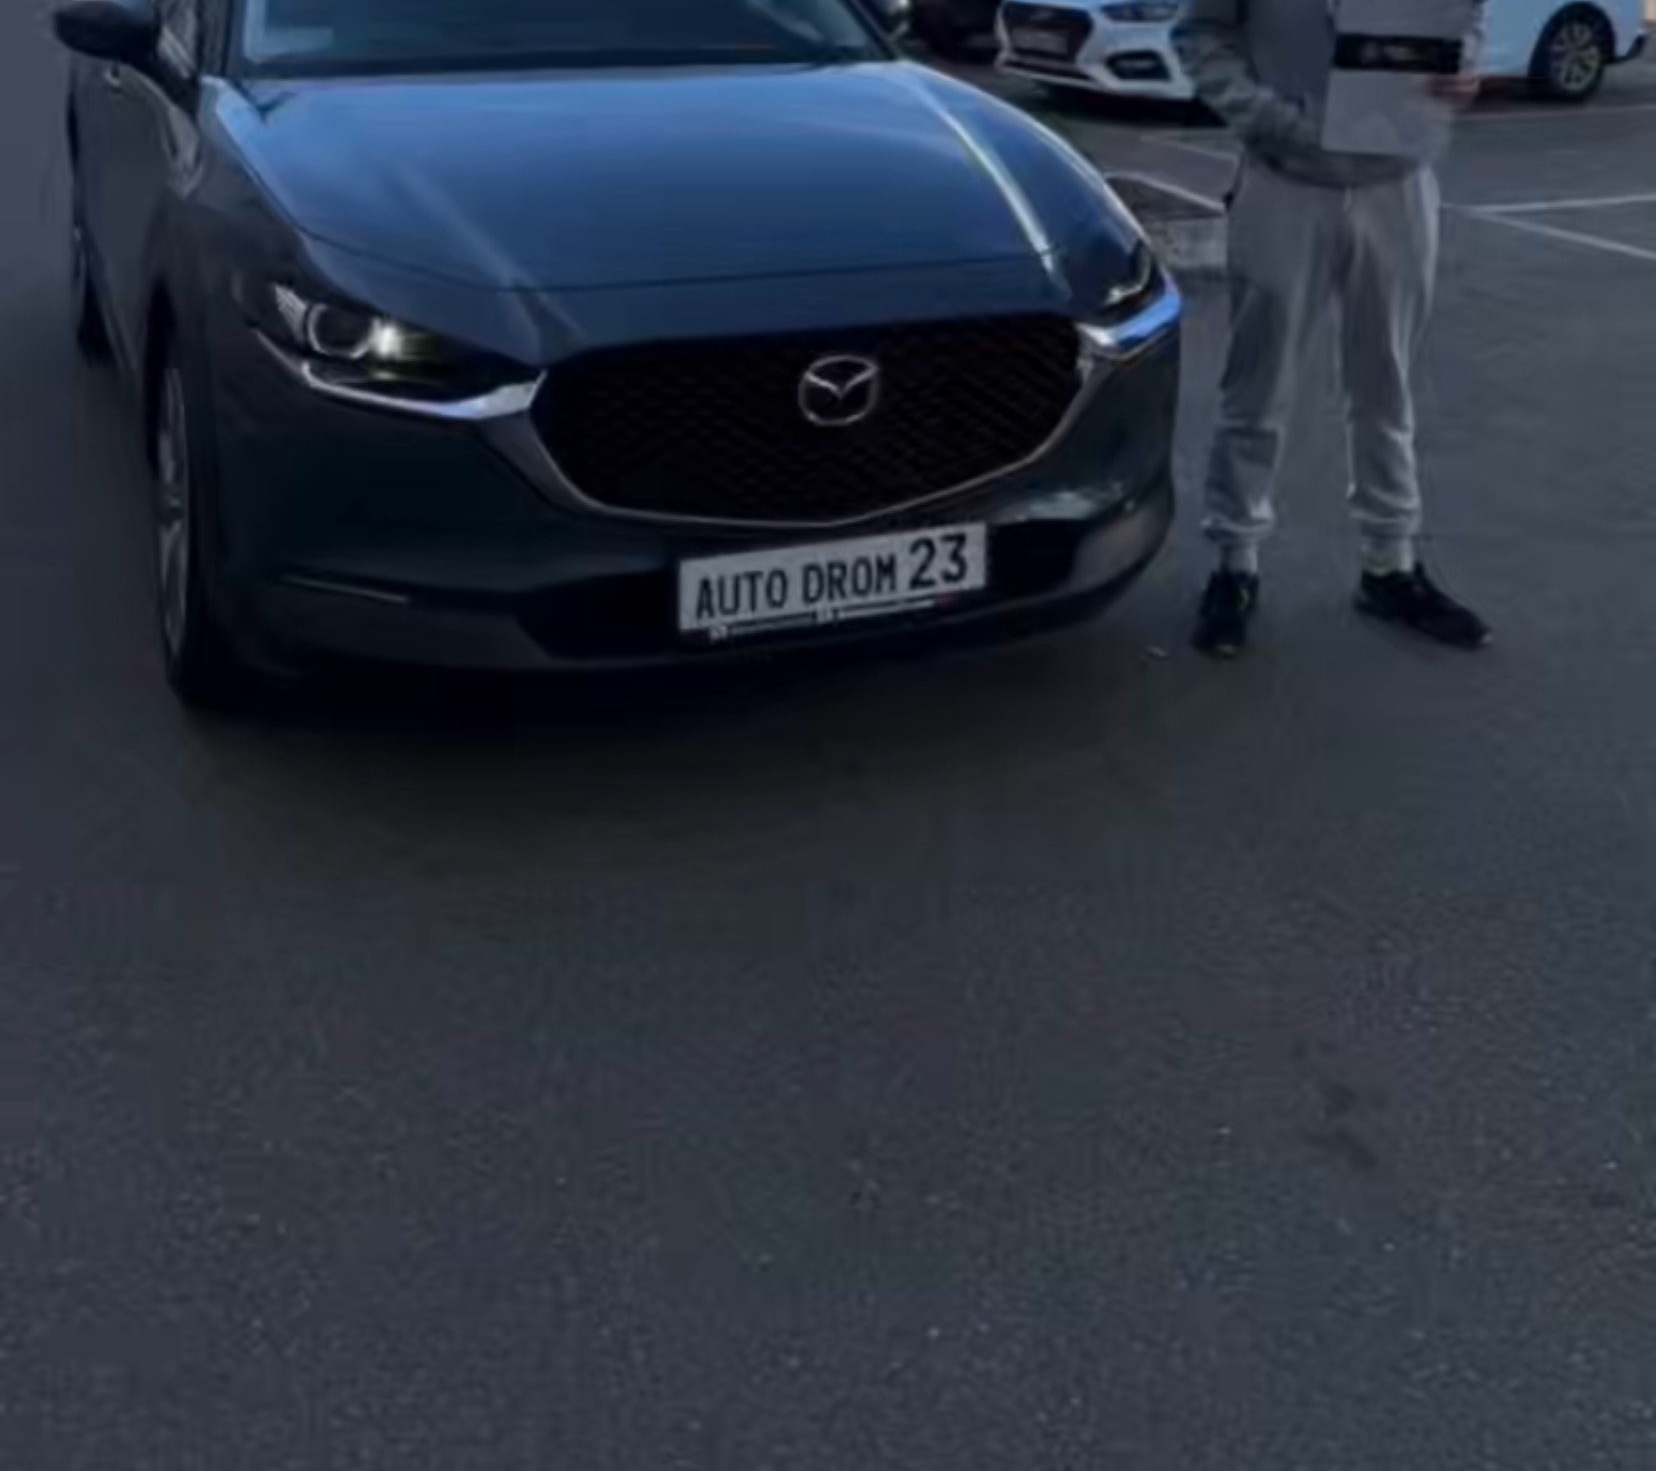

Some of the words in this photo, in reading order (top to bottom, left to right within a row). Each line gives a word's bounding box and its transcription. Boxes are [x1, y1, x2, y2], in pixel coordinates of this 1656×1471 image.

[695, 568, 788, 621] AUTO
[802, 552, 897, 605] DROM
[909, 533, 968, 590] 23
